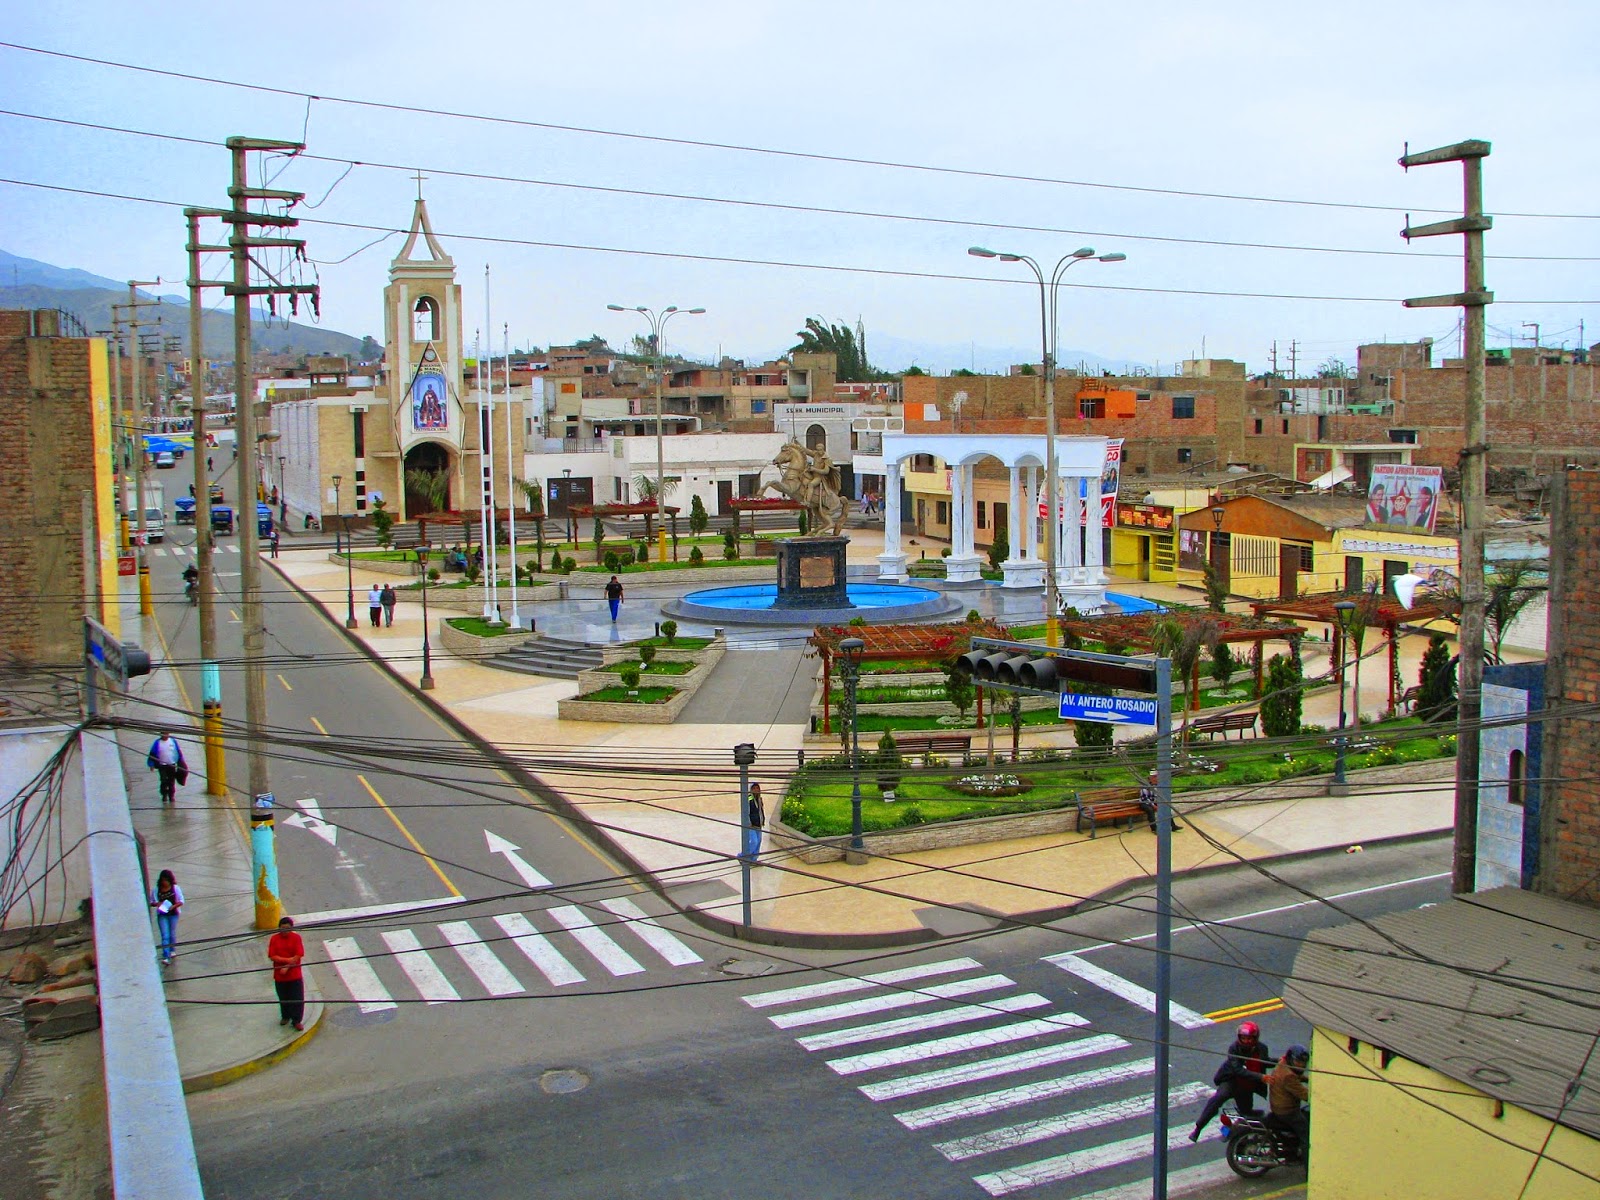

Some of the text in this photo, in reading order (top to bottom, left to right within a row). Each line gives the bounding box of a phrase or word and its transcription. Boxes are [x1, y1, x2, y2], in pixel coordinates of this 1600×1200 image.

[1062, 694, 1155, 714] AV. ANTERO ROSADIO
